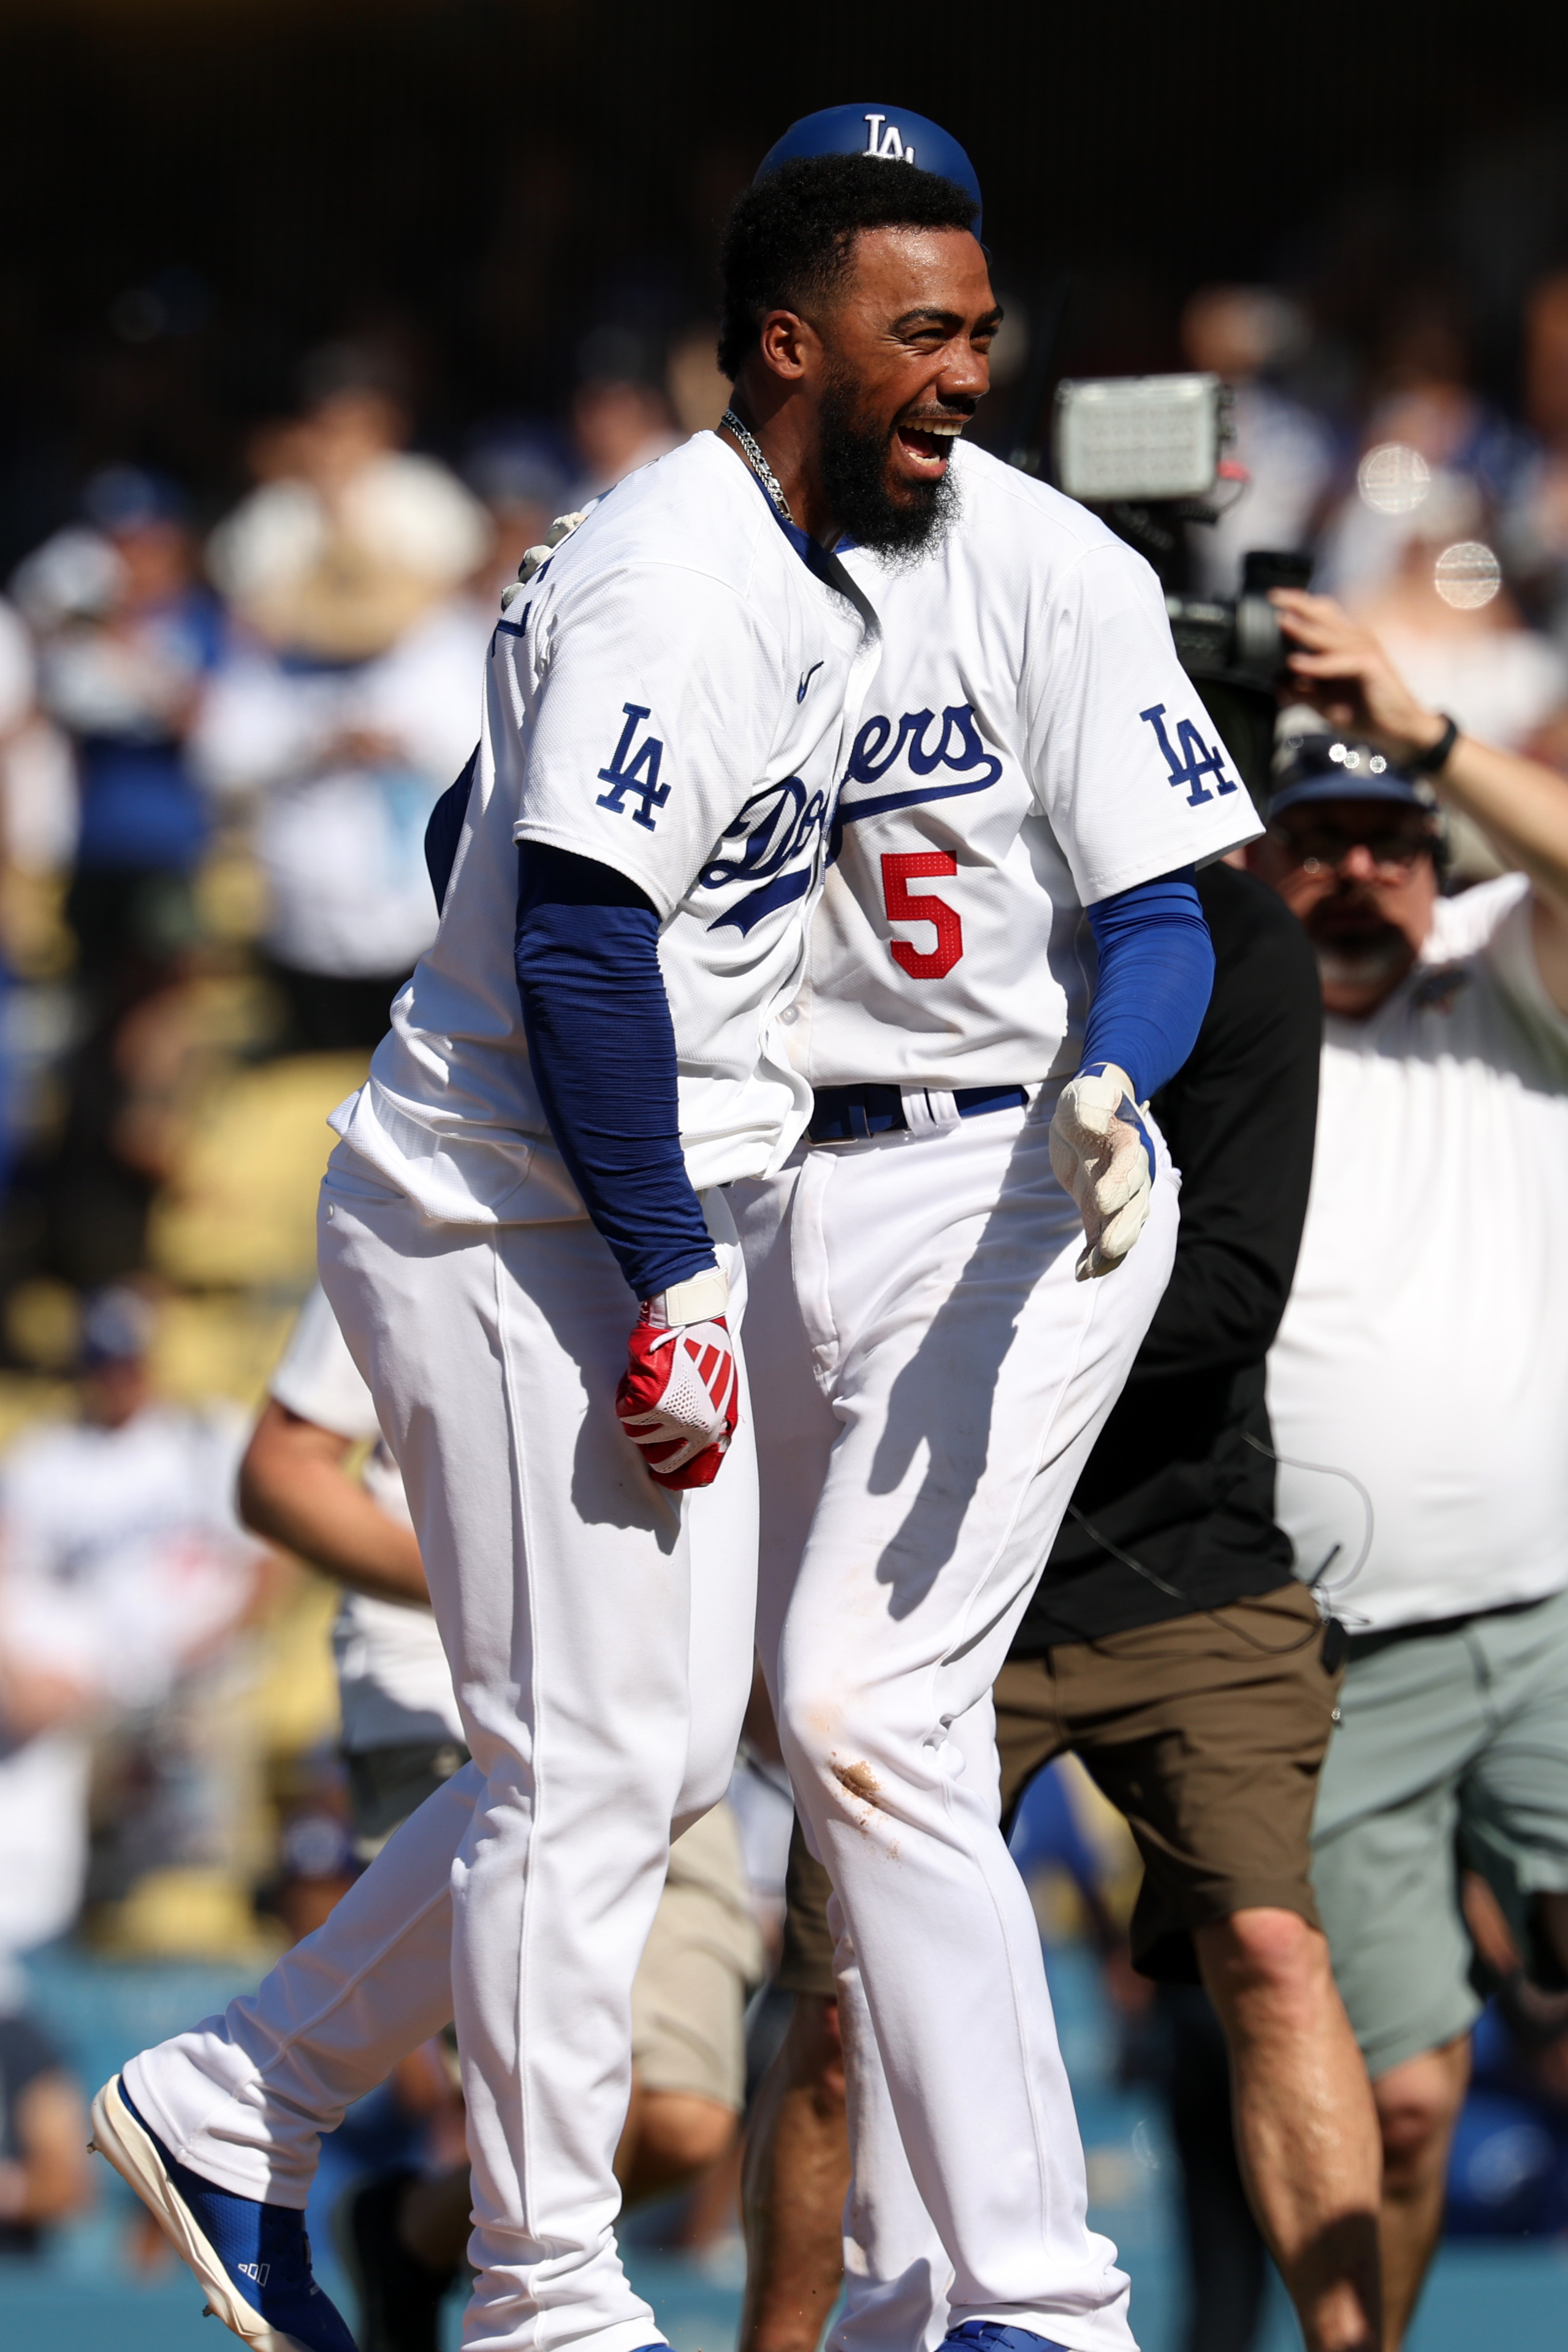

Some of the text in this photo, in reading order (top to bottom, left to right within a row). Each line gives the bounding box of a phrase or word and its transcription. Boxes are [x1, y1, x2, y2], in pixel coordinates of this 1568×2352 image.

[862, 114, 914, 164] LA
[596, 702, 671, 832] LA
[1139, 703, 1238, 807] LA
[698, 775, 832, 889] Do
[881, 850, 963, 979] 5
